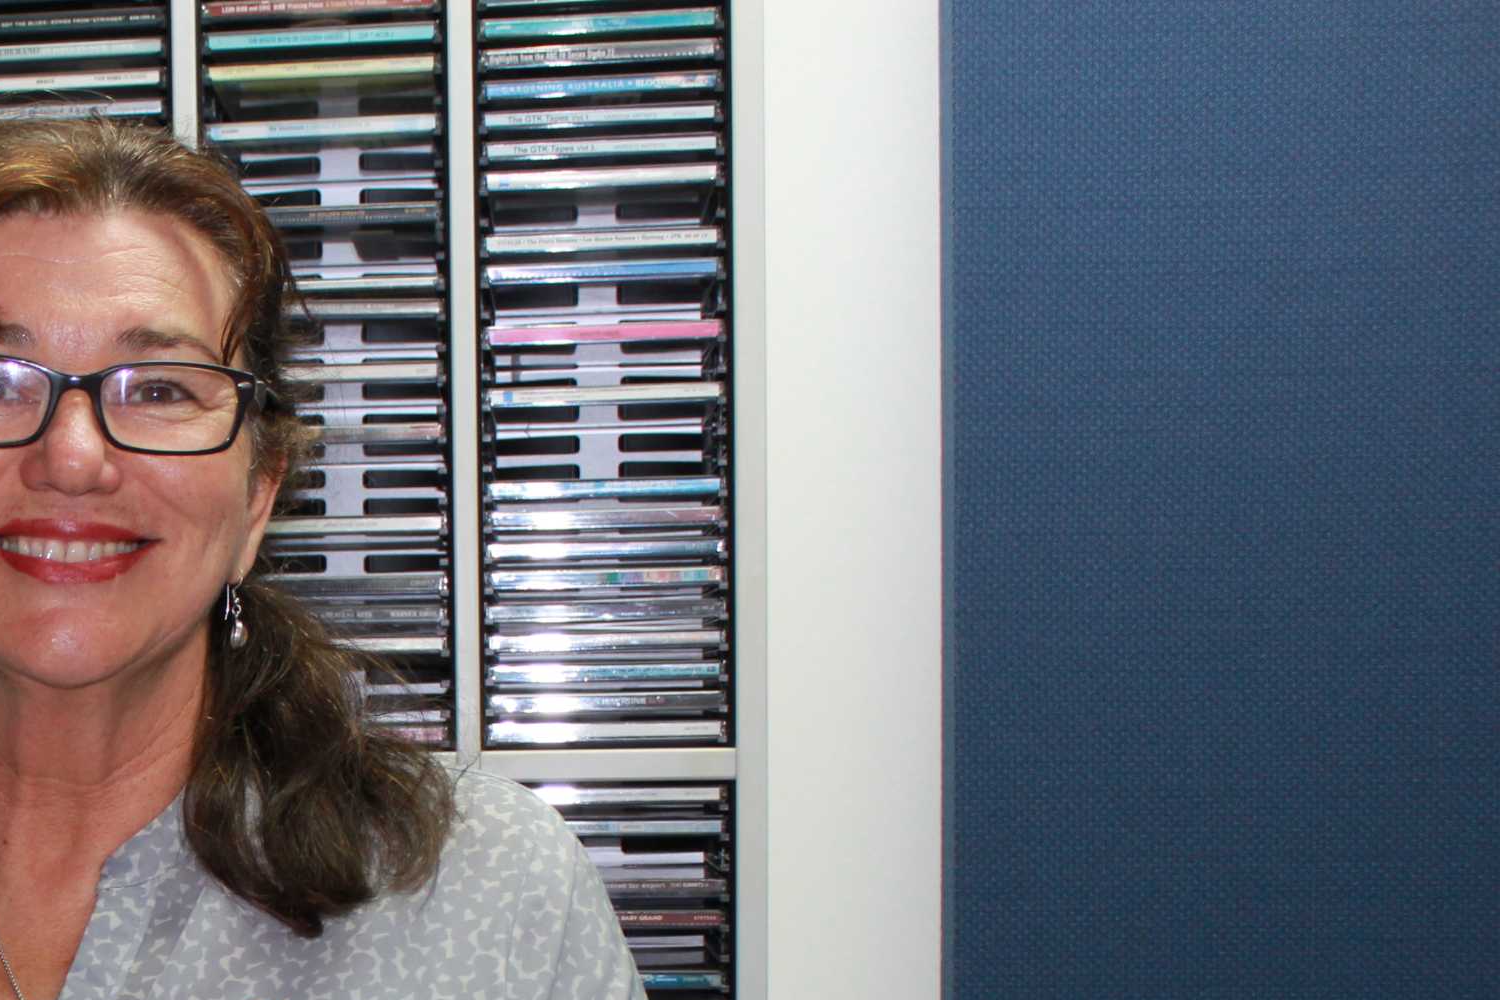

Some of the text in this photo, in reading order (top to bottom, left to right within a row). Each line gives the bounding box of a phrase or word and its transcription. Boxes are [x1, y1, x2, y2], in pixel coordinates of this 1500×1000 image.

[568, 80, 624, 90] AUSTRALIA
[507, 115, 522, 124] The
[524, 114, 543, 123] GTK
[545, 114, 570, 125] Tapes
[513, 145, 528, 154] The
[530, 144, 549, 154] GTK
[551, 144, 576, 155] Tapes
